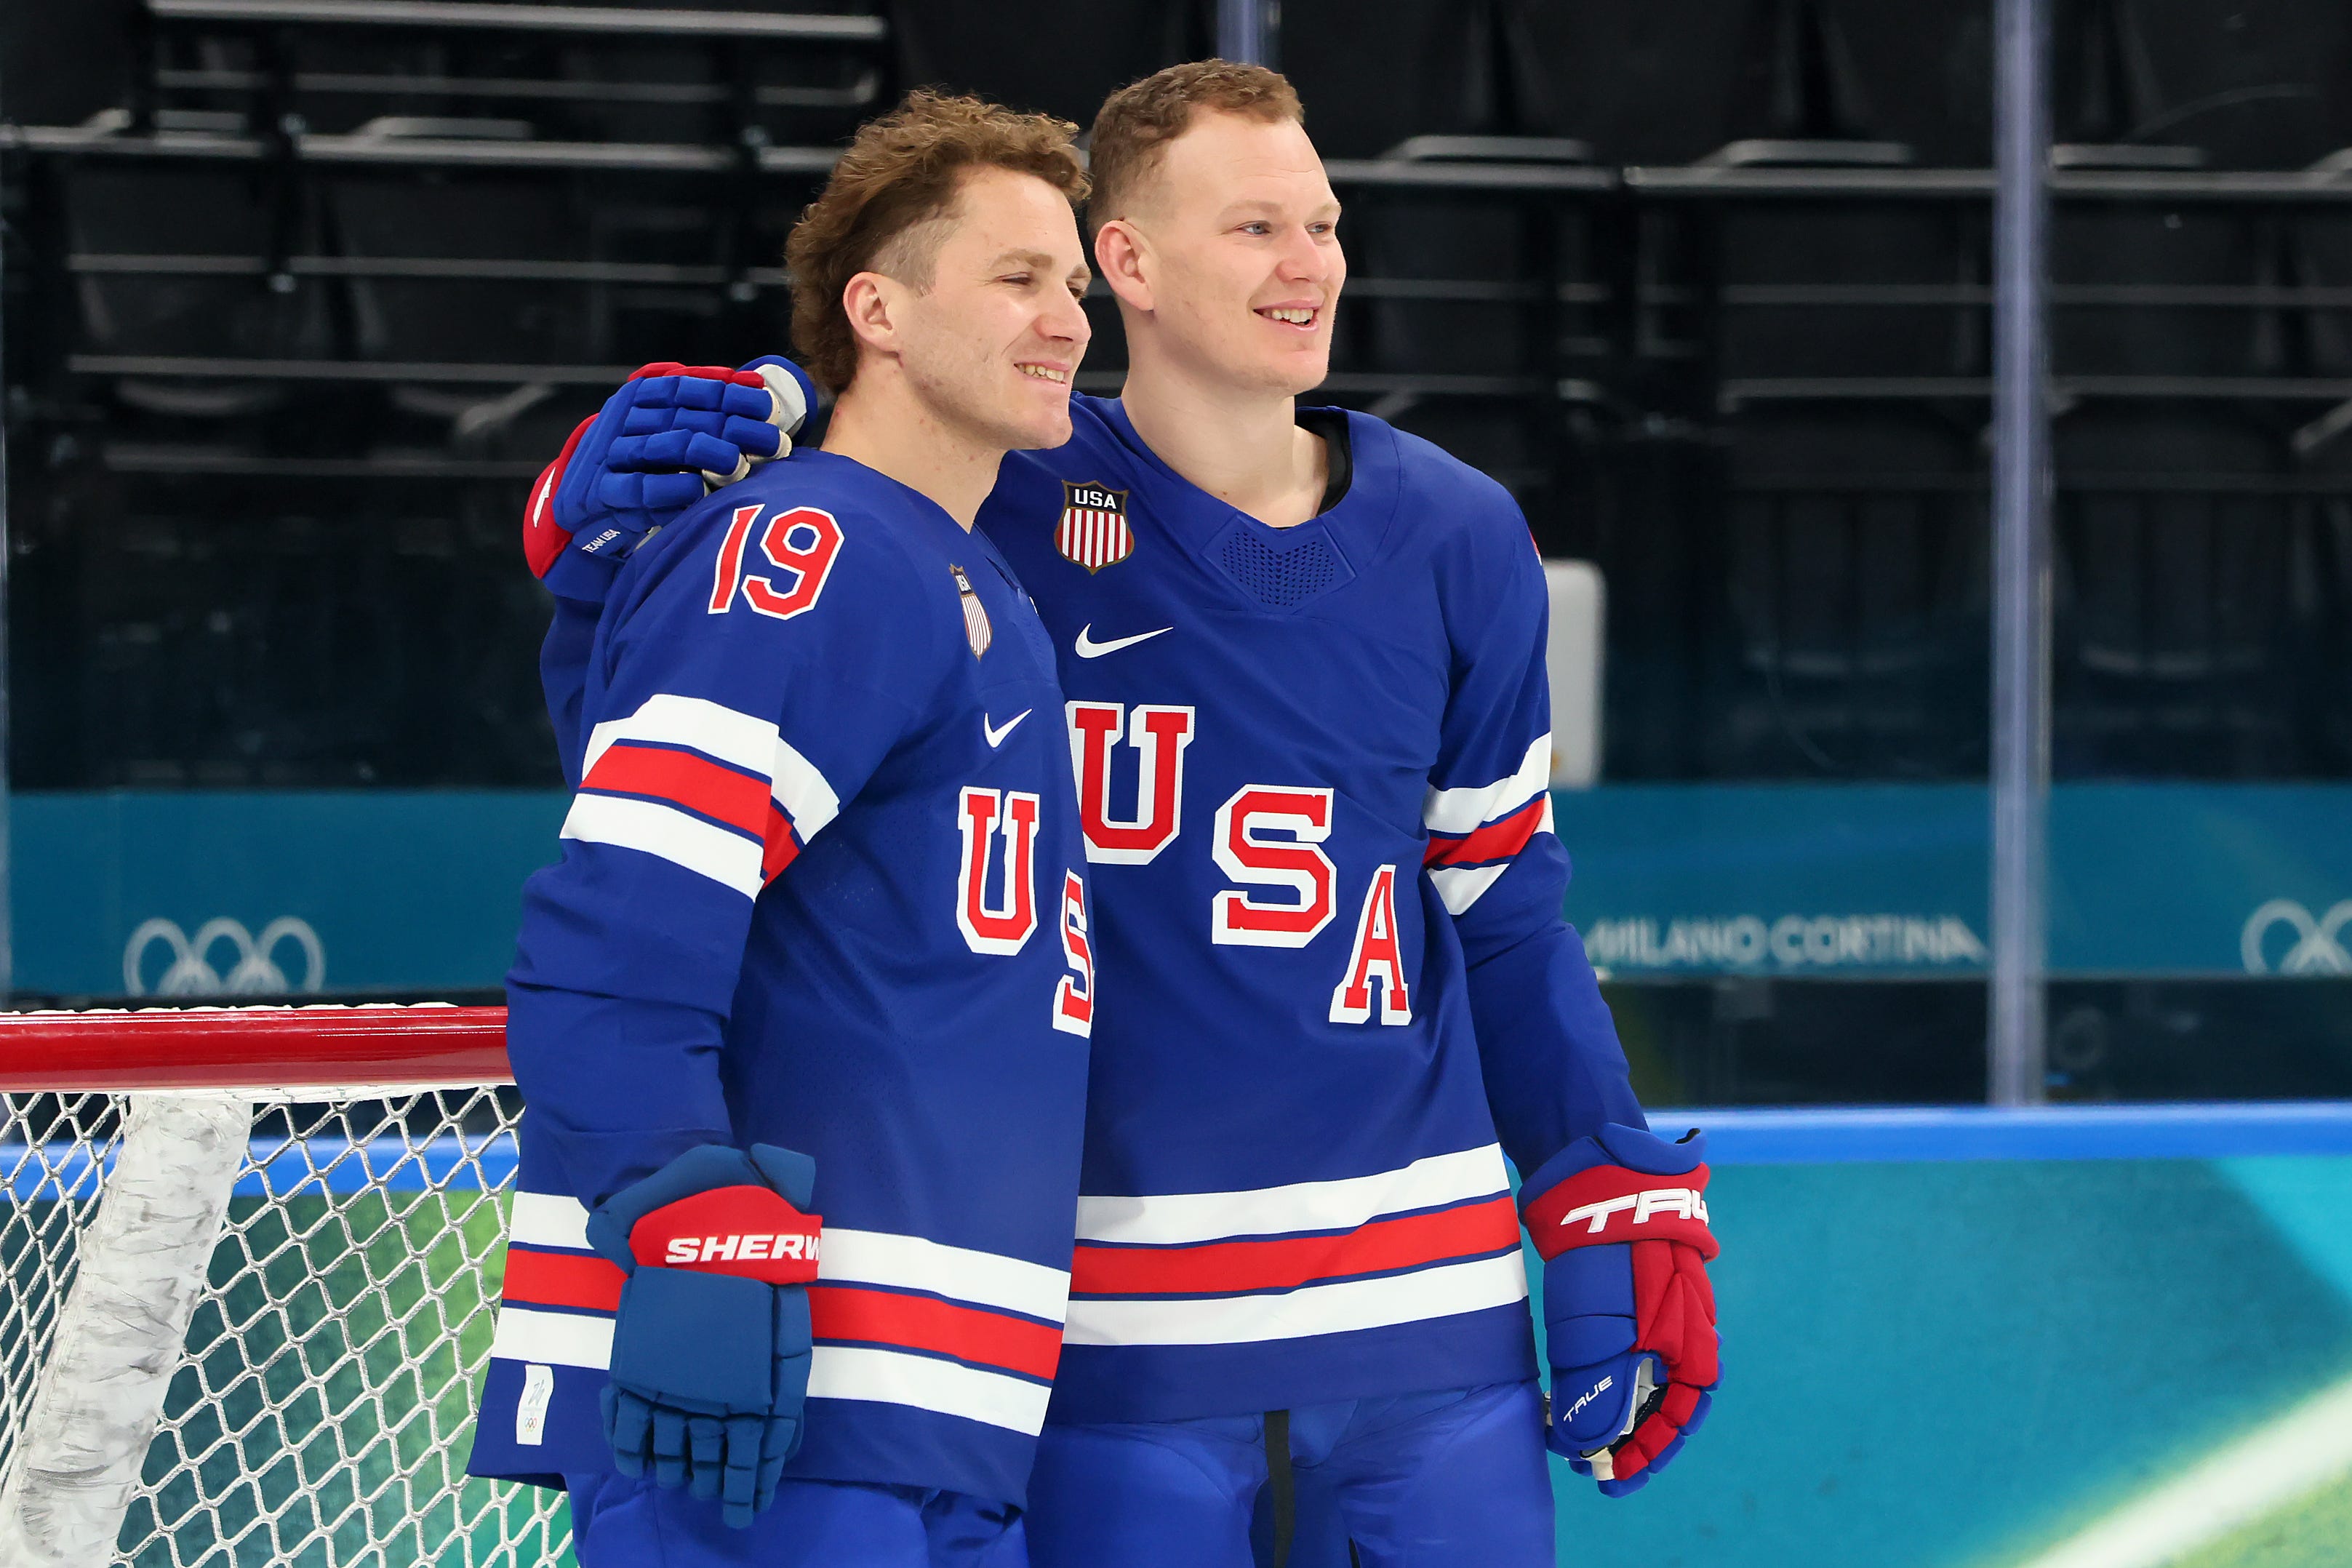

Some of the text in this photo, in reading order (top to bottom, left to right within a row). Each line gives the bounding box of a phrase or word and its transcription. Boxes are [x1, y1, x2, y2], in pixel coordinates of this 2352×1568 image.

[1075, 488, 1117, 509] USA
[582, 537, 607, 553] TEAM
[708, 503, 845, 620] 19
[1584, 913, 1991, 965] MILANO CORTINA
[1563, 1375, 1614, 1423] TRUE
